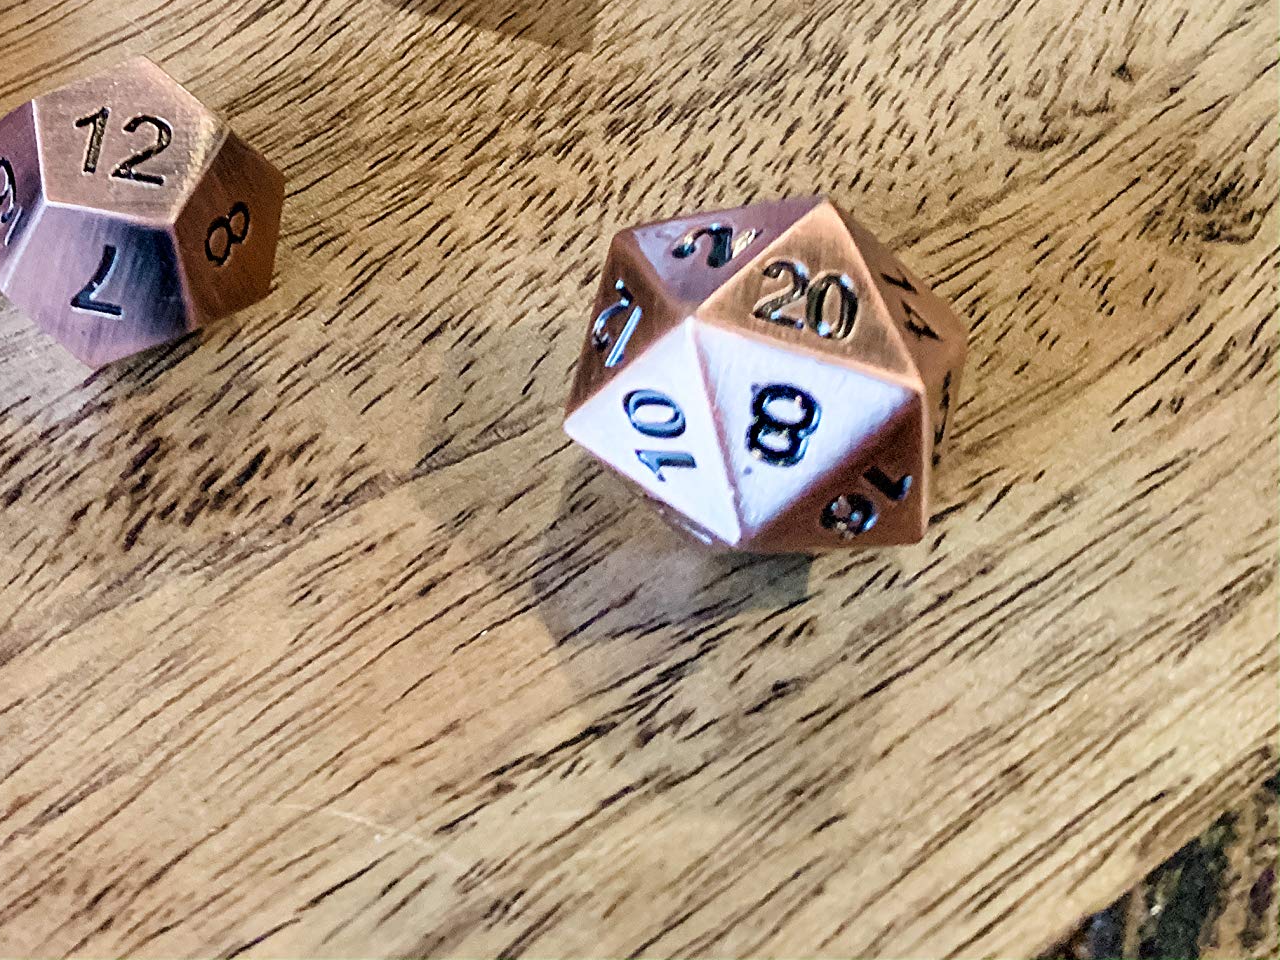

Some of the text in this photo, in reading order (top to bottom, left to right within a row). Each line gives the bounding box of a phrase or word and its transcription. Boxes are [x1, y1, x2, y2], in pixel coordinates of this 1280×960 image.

[73, 106, 173, 187] 12
[204, 200, 251, 267] 8
[70, 243, 124, 321] 7
[750, 259, 861, 341] 20
[622, 387, 698, 482] 10
[745, 382, 822, 468] 8
